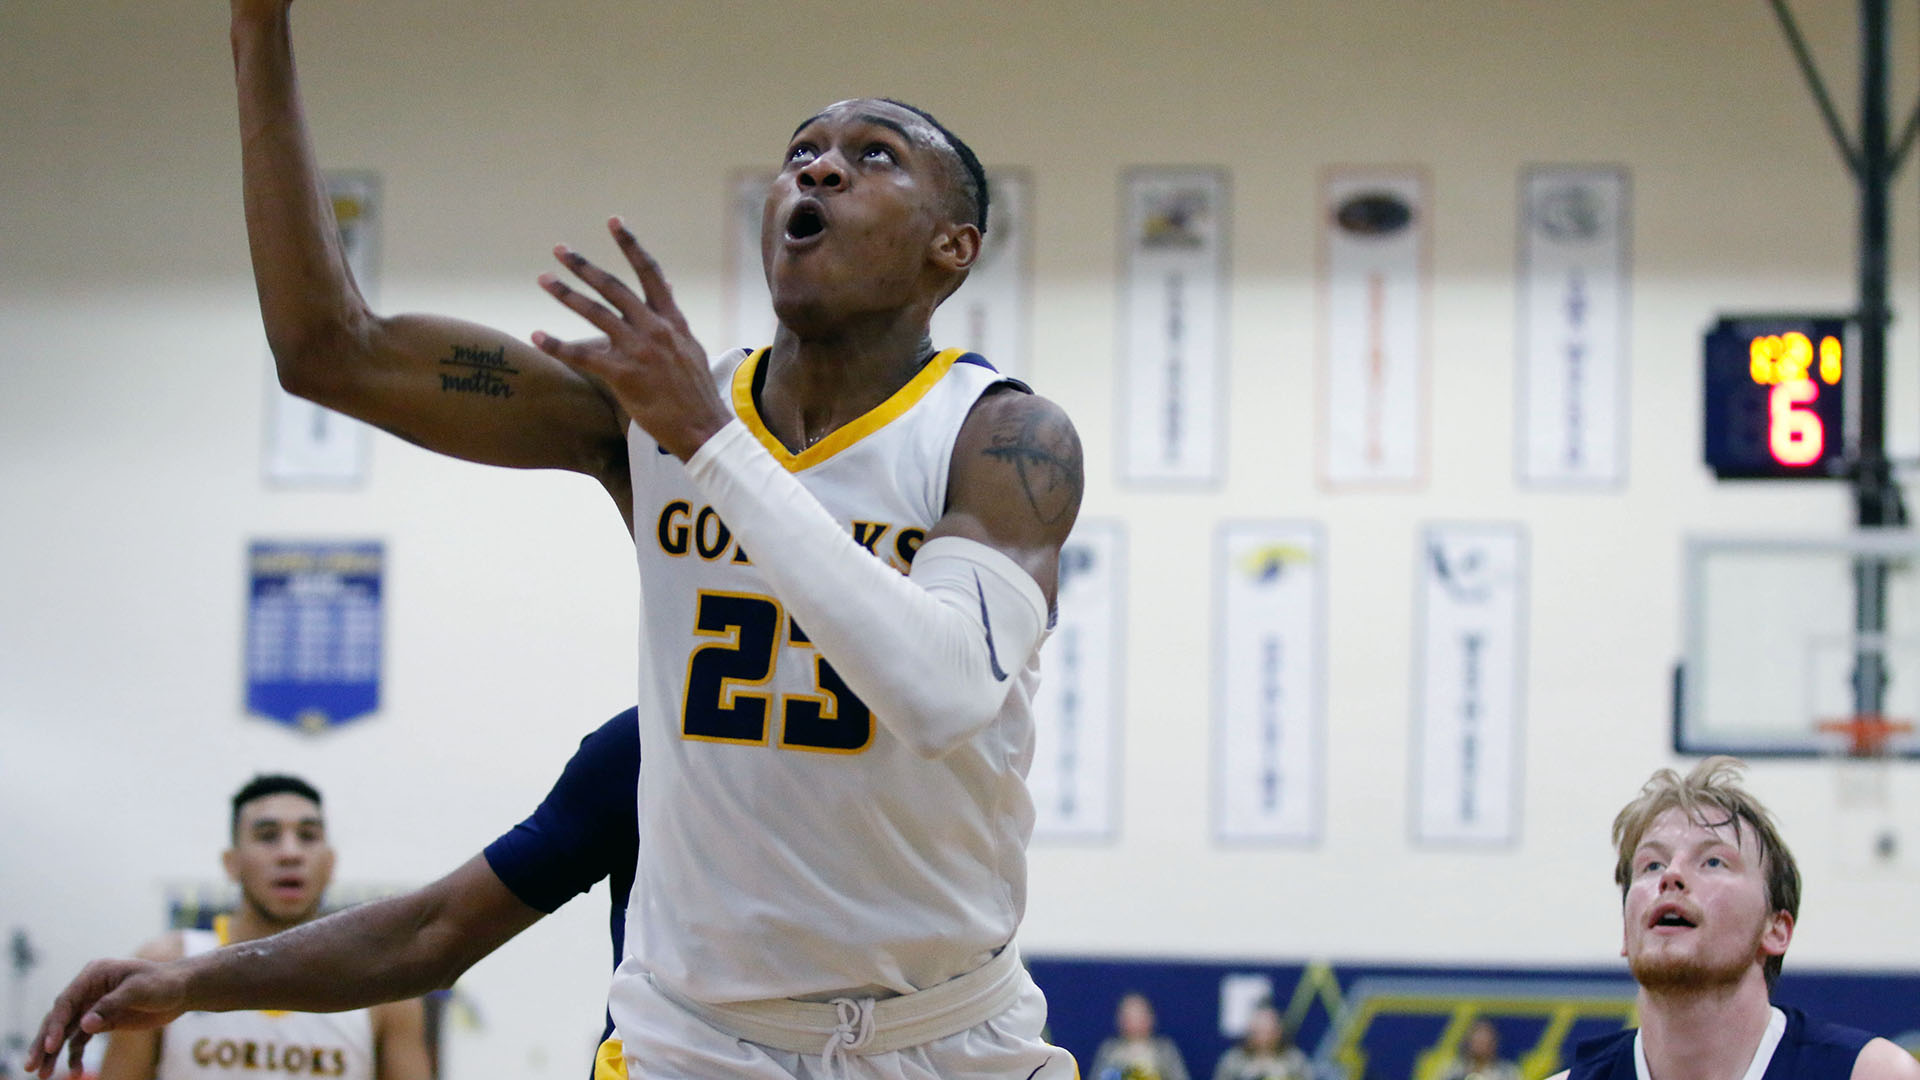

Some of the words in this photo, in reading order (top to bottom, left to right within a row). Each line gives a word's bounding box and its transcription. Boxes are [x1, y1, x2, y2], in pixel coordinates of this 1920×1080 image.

[438, 369, 515, 399] matter
[1767, 378, 1825, 467] 6
[657, 498, 927, 577] GOKS
[681, 588, 878, 755] 23
[192, 1037, 346, 1077] GORLOKS
